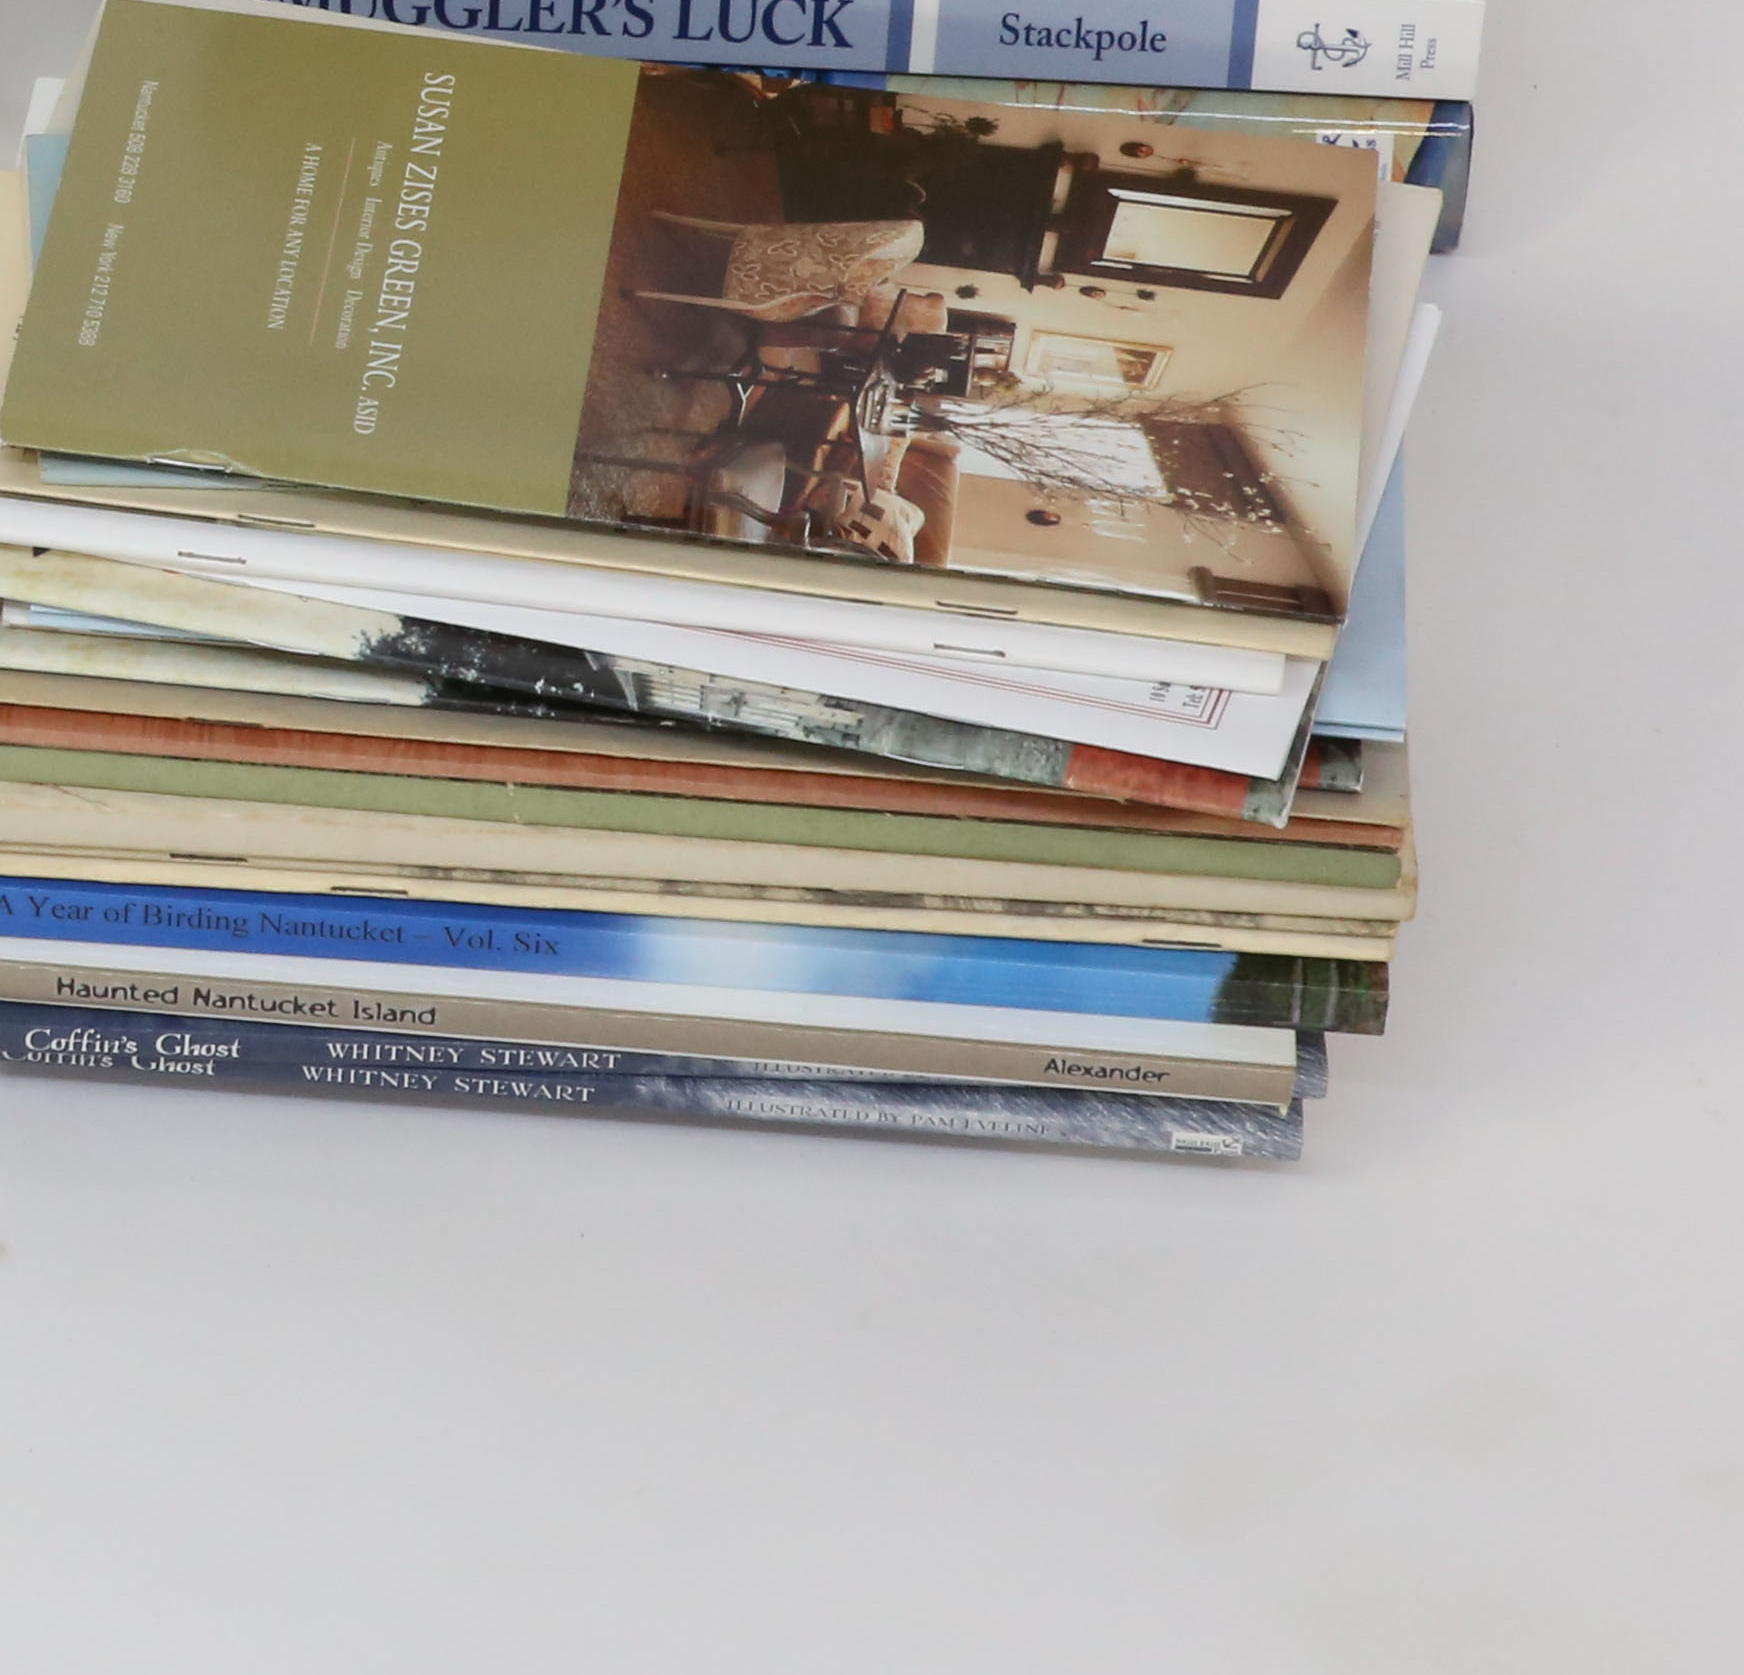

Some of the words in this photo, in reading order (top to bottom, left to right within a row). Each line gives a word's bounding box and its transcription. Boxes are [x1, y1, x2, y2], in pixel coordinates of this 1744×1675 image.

[998, 11, 1168, 62] Stackpole
[1398, 23, 1417, 50] Hill
[1419, 36, 1438, 70] Press
[1395, 53, 1414, 81] Mill
[412, 72, 456, 158] SUSAN
[297, 155, 320, 196] HOME
[393, 162, 438, 231] ZISES
[290, 198, 311, 225] FOR
[283, 231, 303, 259] ANY
[267, 260, 297, 330] LOCATION
[367, 235, 423, 333] GREEN,
[360, 338, 403, 393] INC.
[353, 395, 380, 435] ASID
[28, 896, 97, 923] Year
[141, 904, 250, 939] Birding
[258, 912, 404, 945] Nantucket
[443, 925, 504, 953] Vol.
[513, 930, 561, 957] Six
[24, 1028, 138, 1054] Coffin's
[155, 1032, 241, 1059] Ghost
[326, 1042, 464, 1066] WHITNEY
[480, 1048, 622, 1072] STEWART
[56, 975, 179, 1006] Haunted
[193, 987, 340, 1019] Nantucket
[353, 998, 438, 1027] Island
[1043, 1056, 1171, 1085] Alexander
[301, 1065, 440, 1092] WHITNEY
[453, 1078, 596, 1103] STEWART
